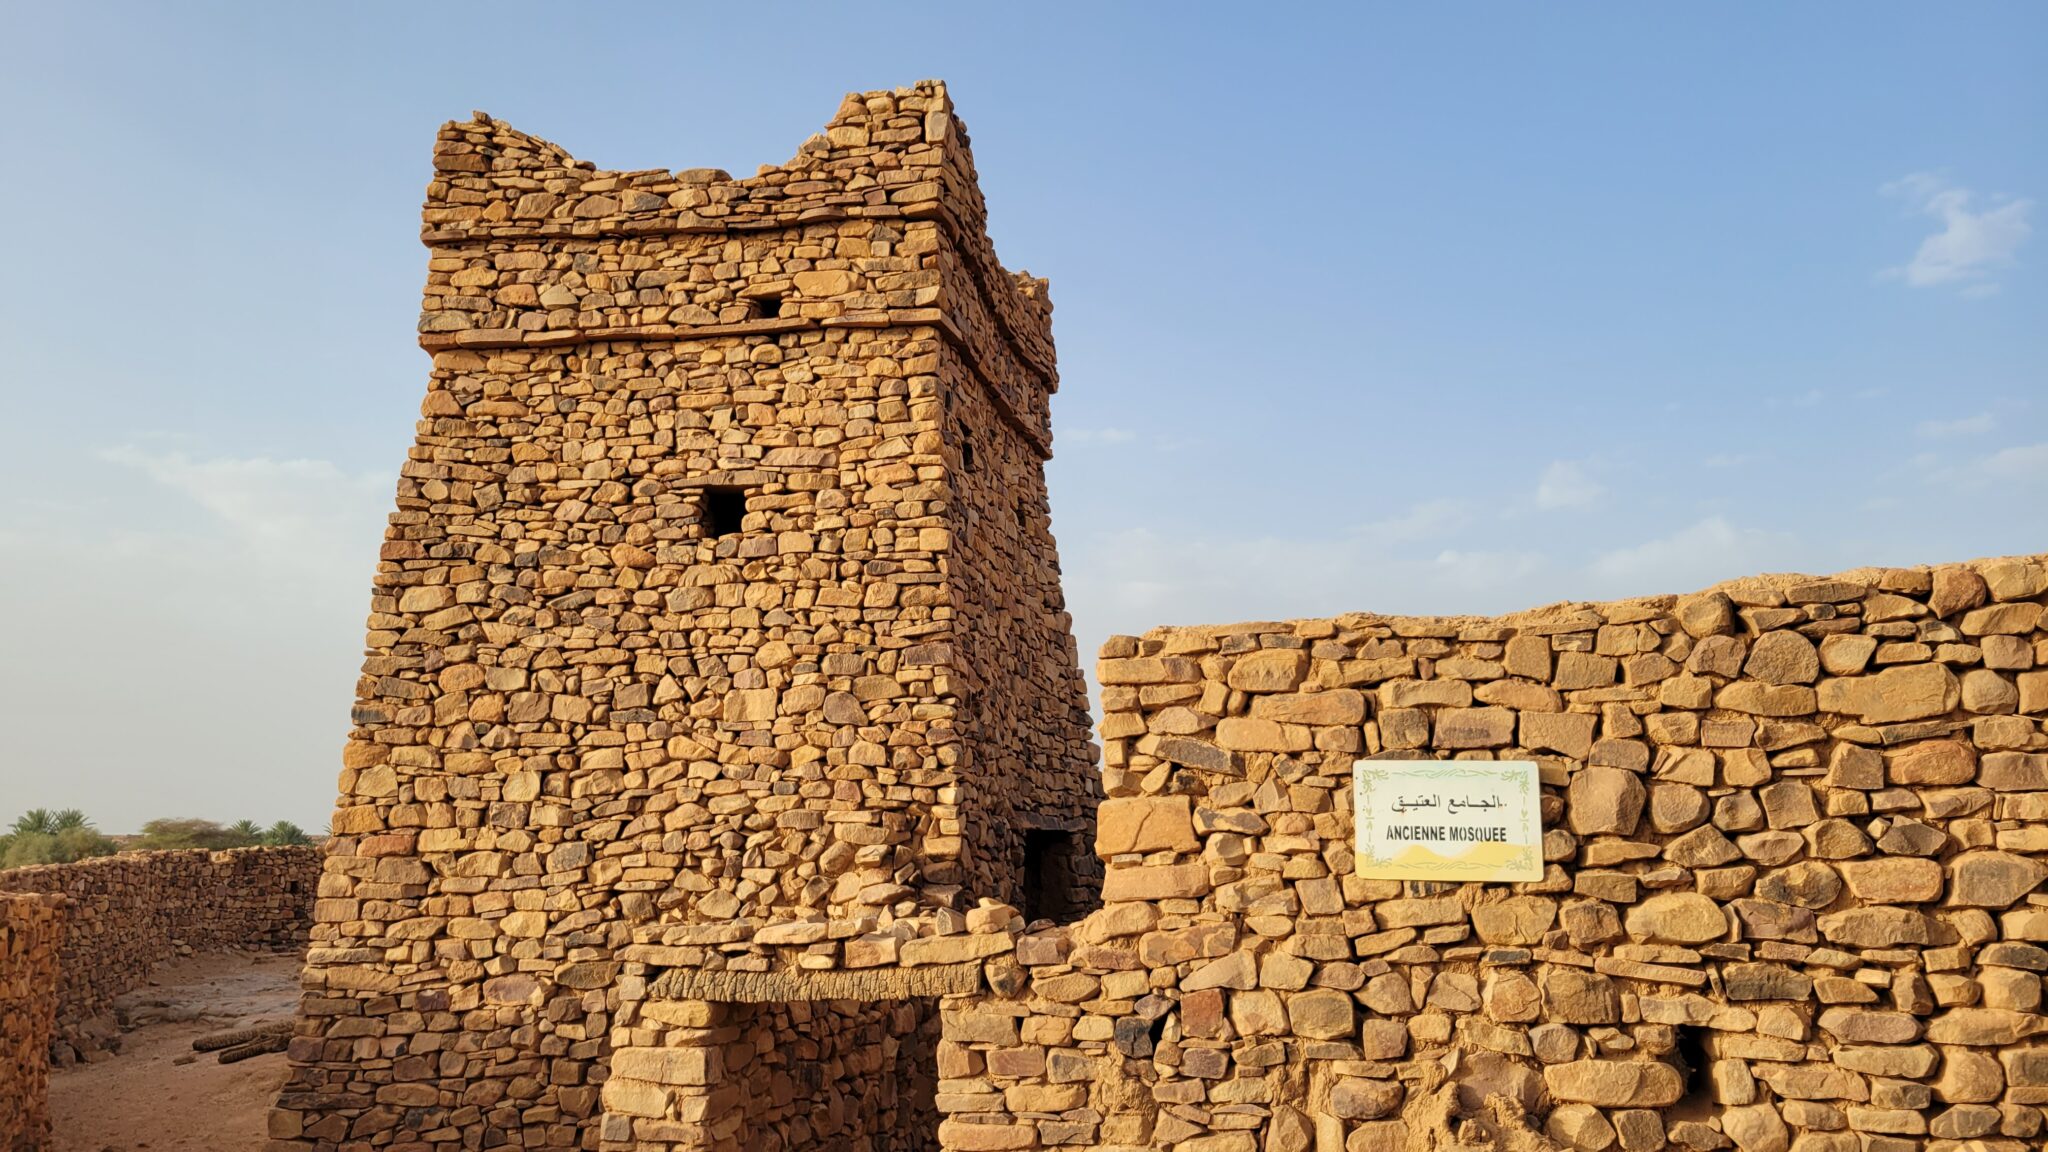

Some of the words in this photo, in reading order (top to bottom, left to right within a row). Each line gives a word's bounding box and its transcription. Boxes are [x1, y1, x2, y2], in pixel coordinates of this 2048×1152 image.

[1391, 794, 1441, 813] العتيق
[1447, 794, 1500, 814] الجامع
[1386, 825, 1445, 841] ANCIENNE
[1450, 826, 1507, 842] MOSQUEE
